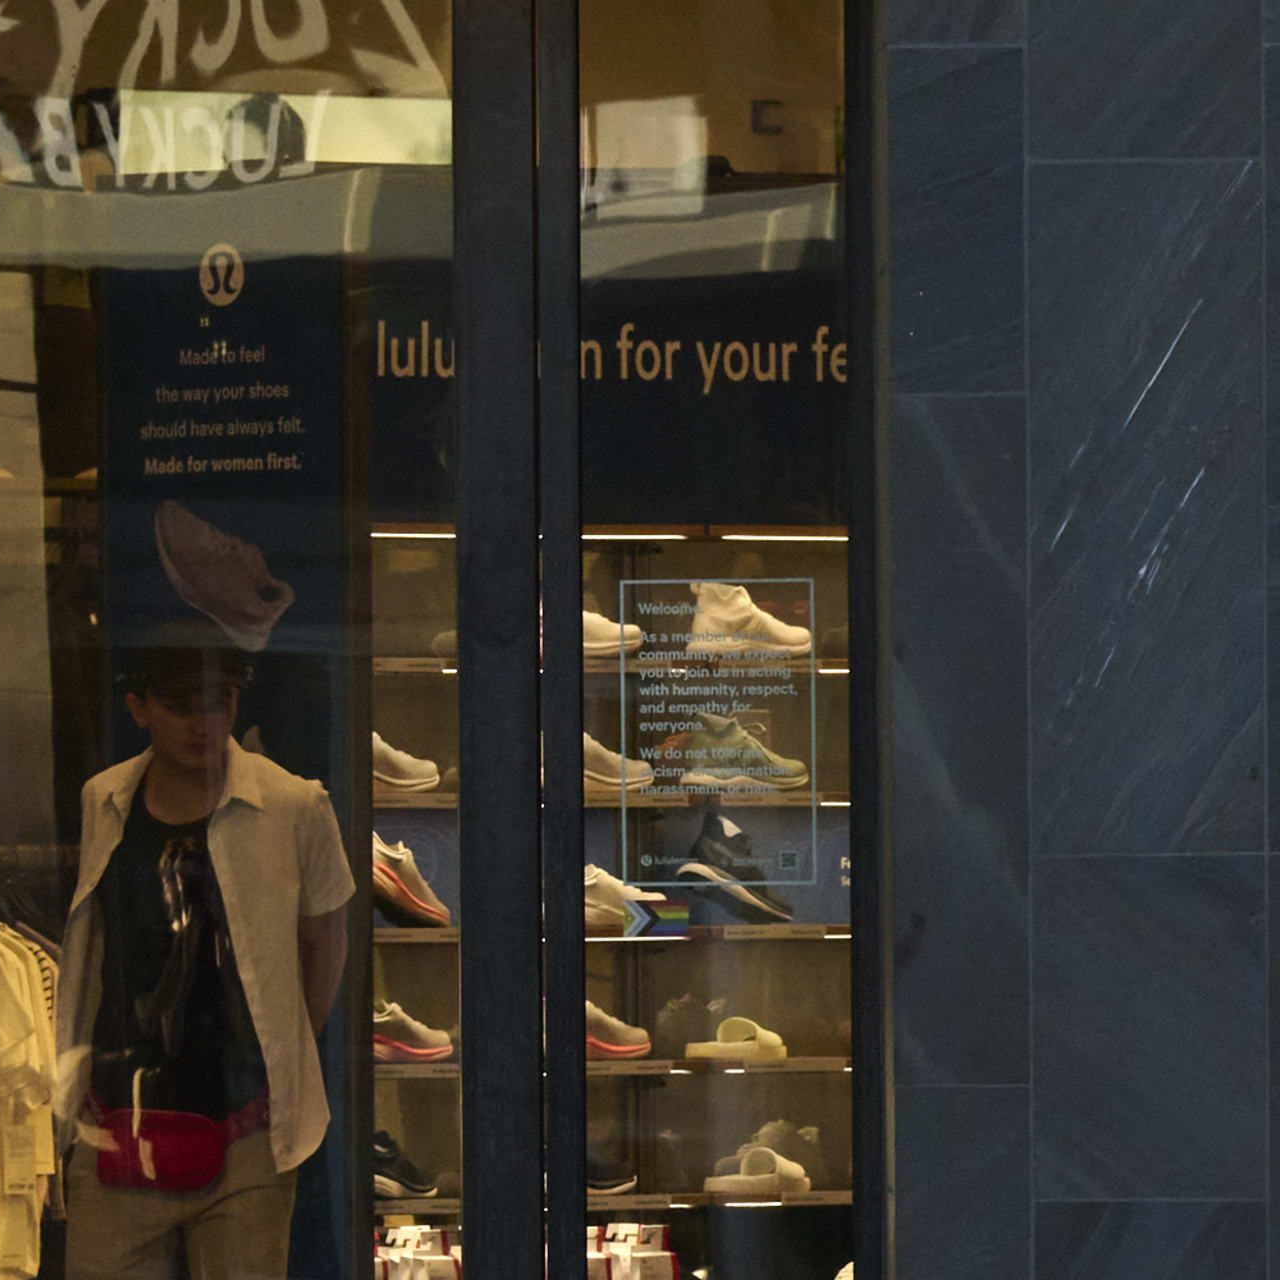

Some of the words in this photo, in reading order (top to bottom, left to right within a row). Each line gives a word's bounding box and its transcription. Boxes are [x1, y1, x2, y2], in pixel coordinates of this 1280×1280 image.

[178, 347, 218, 366] Made
[240, 345, 265, 363] feel
[617, 322, 680, 381] for
[696, 339, 798, 395] your
[155, 385, 178, 403] the
[183, 387, 210, 404] way
[214, 385, 246, 403] your
[248, 380, 289, 400] shoes
[140, 420, 187, 439] should
[190, 420, 223, 437] have
[227, 418, 274, 438] always
[278, 416, 306, 433] felt.
[144, 457, 184, 475] Made
[187, 455, 208, 472] for
[211, 458, 263, 472] women
[266, 452, 302, 471] first.
[659, 634, 669, 642] a
[639, 668, 664, 681] you
[713, 668, 729, 678] us
[639, 683, 669, 696] with
[672, 683, 740, 697] humanity,
[639, 701, 665, 714] and
[669, 700, 729, 715] empathy
[732, 700, 752, 713] for
[640, 747, 661, 760] We
[664, 747, 683, 760] do
[685, 747, 708, 760] not
